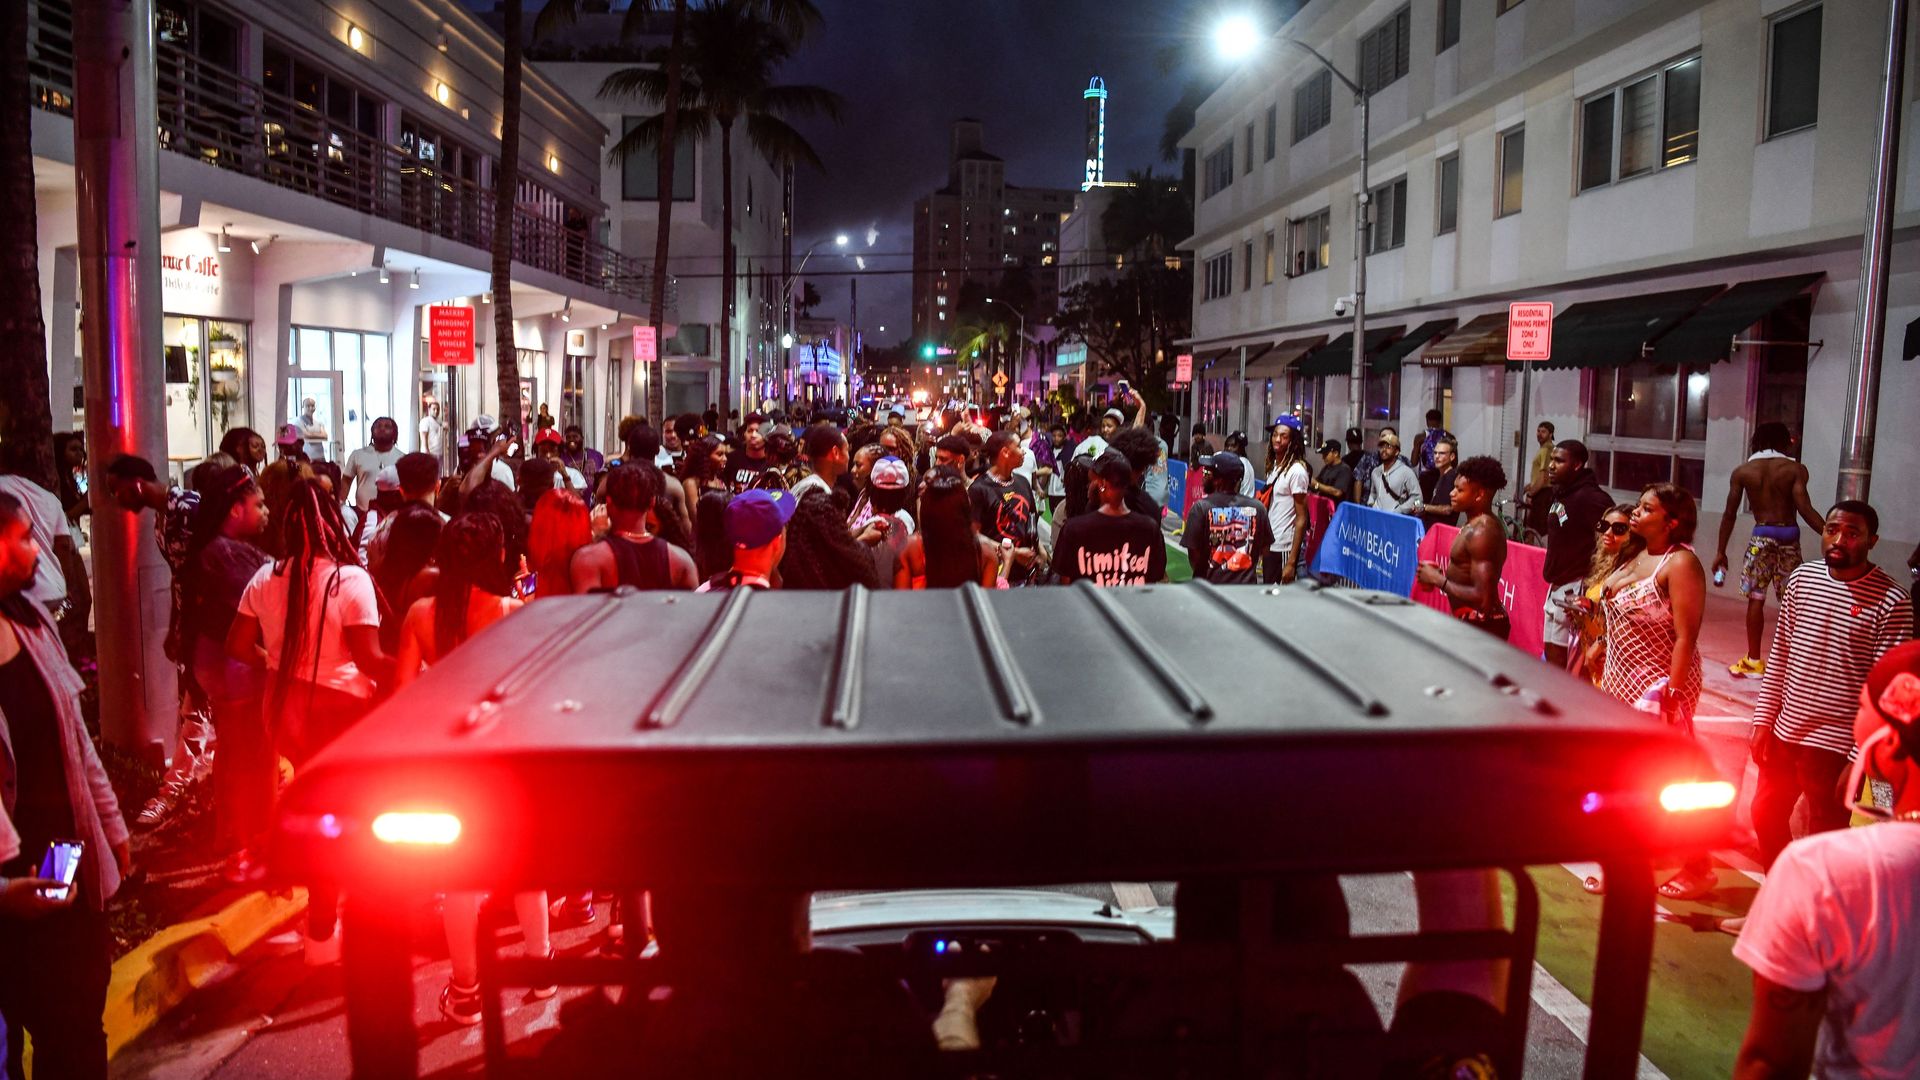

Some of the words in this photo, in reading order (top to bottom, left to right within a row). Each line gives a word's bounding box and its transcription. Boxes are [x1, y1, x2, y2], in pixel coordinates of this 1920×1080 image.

[1517, 309, 1544, 317] RESIDENTIAL
[433, 319, 470, 327] EMERGENCY
[1533, 320, 1548, 328] PERMIT
[1521, 330, 1534, 338] ZONE
[438, 340, 466, 348] VEHICLES
[443, 350, 461, 358] ONLY
[1078, 542, 1151, 575] limited
